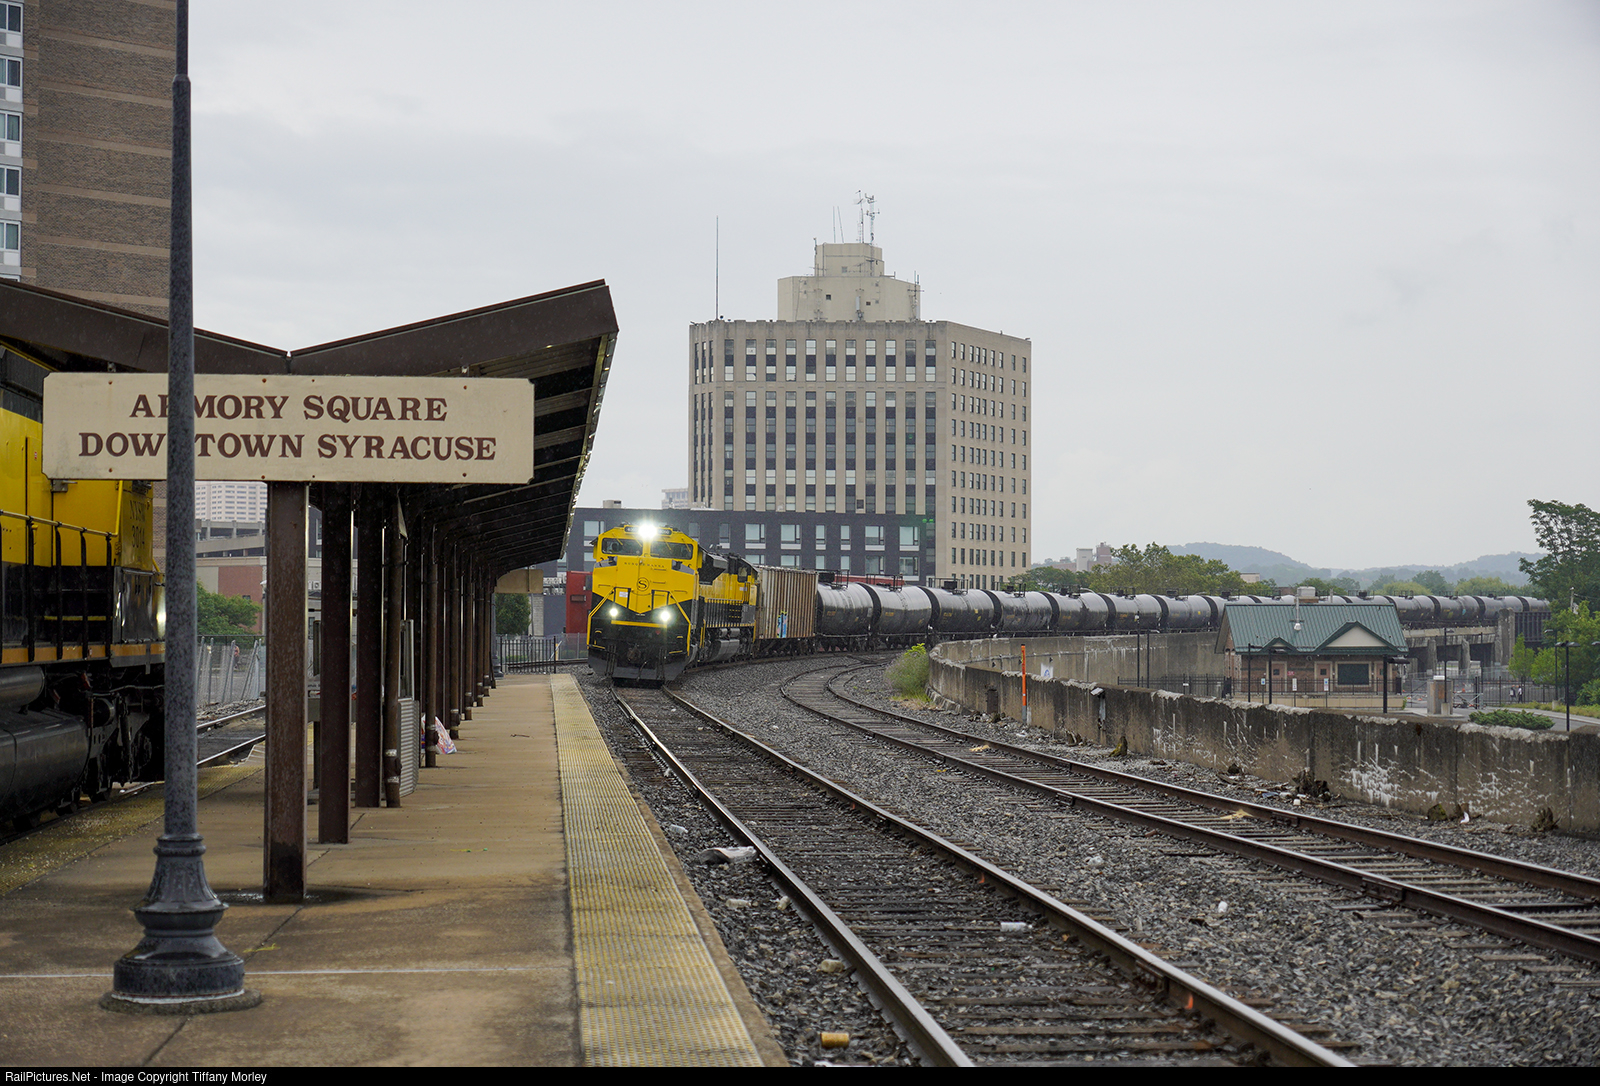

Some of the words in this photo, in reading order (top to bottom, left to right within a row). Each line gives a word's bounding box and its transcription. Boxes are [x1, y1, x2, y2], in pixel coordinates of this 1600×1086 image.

[303, 394, 448, 424] SQUARE
[78, 432, 305, 458] DOWTOWN
[317, 434, 497, 461] SYRACUSE
